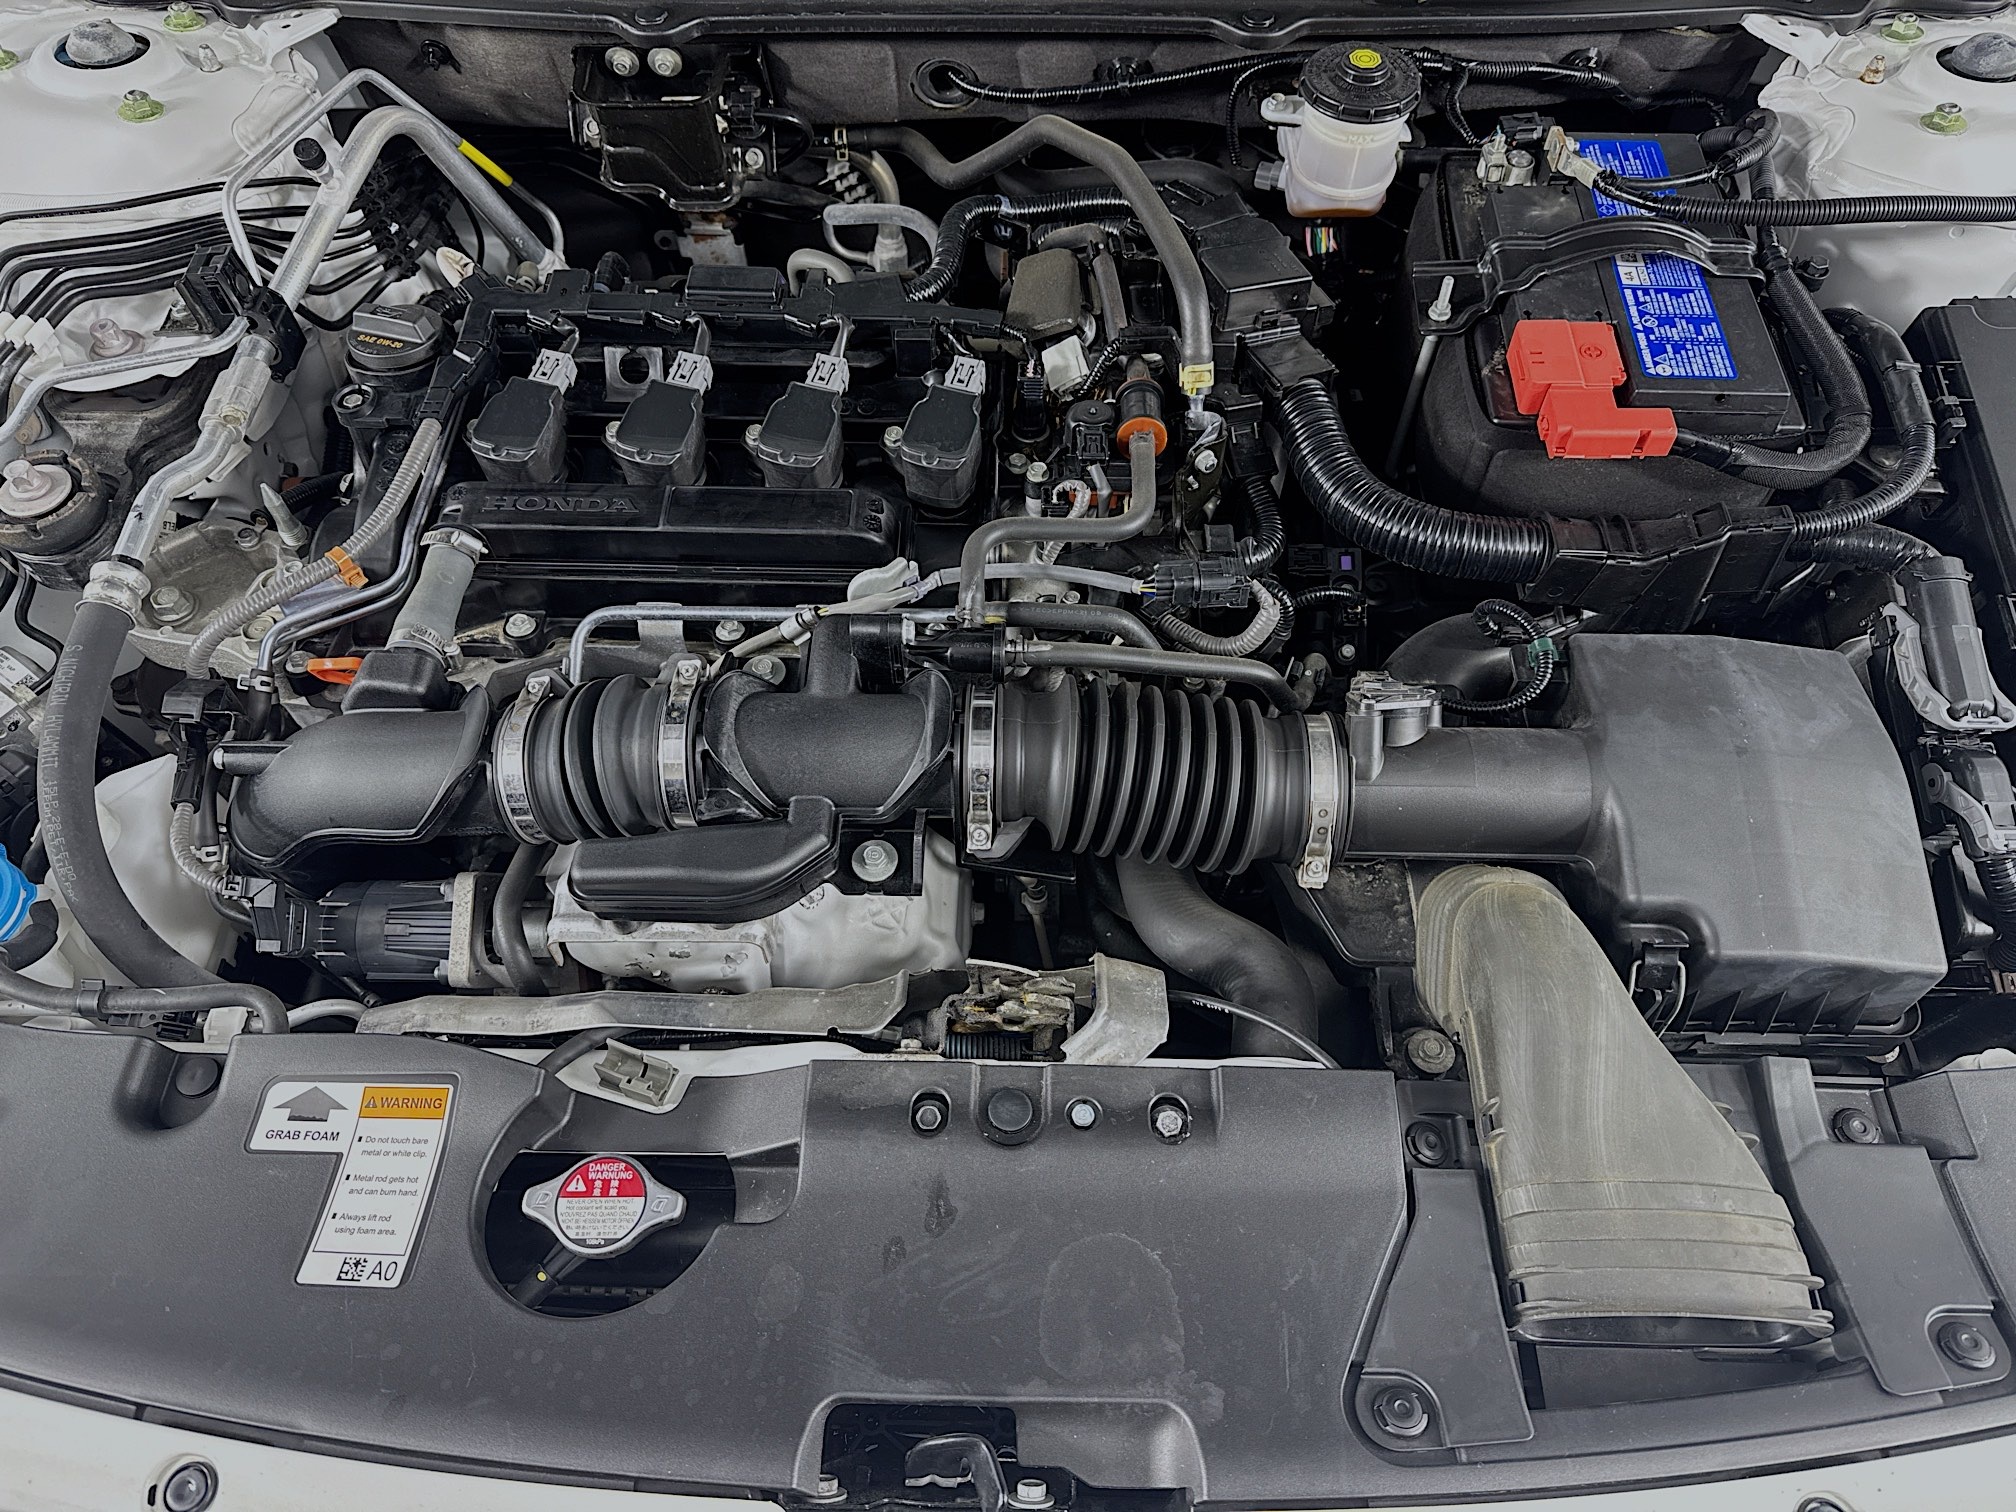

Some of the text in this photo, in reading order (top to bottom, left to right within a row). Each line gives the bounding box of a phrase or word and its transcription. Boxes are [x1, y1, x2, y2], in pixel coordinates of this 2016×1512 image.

[357, 334, 378, 344] SAE
[376, 336, 404, 349] 0W-20
[482, 496, 640, 513] HONDA
[380, 1096, 443, 1109] WARNING
[265, 1129, 341, 1142] GRAB FOAM
[365, 1135, 376, 1143] Do
[390, 1137, 411, 1145] touch
[411, 1137, 429, 1145] bare
[361, 1148, 383, 1157] metal
[392, 1149, 412, 1157] white
[412, 1149, 428, 1160] clip.
[588, 1162, 626, 1172] DANGER
[353, 1173, 419, 1185] Metal rod gets hot
[588, 1171, 634, 1180] WARNUNG
[348, 1187, 364, 1195] and
[379, 1188, 397, 1196] burn
[398, 1189, 419, 1197] hand.
[339, 1212, 392, 1223] Always lift rod
[598, 1210, 618, 1218] QUAND
[335, 1225, 397, 1236] using foam area.
[366, 1260, 398, 1281] A0
